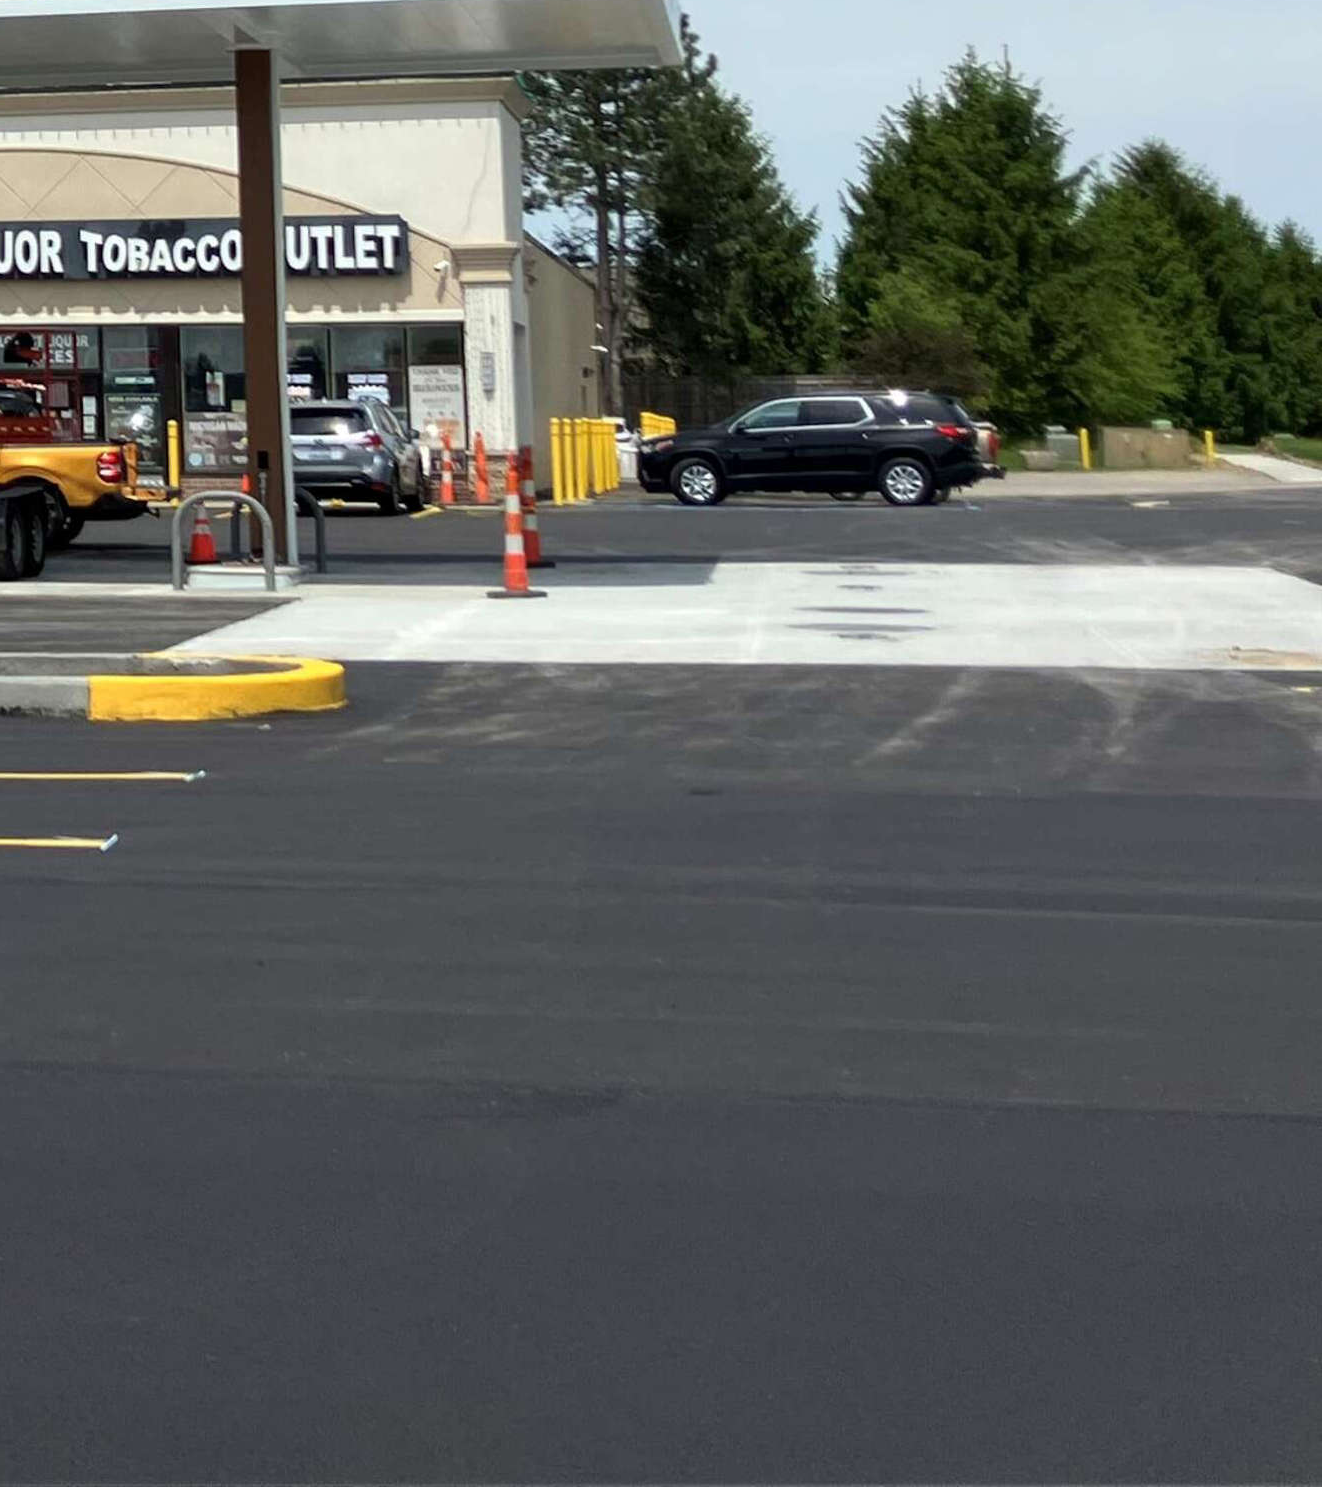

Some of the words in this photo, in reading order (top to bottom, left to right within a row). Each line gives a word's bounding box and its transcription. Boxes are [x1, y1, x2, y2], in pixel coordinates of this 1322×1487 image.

[79, 229, 243, 274] TOBACCO
[285, 224, 401, 271] UTLET
[48, 335, 89, 348] IQUOR
